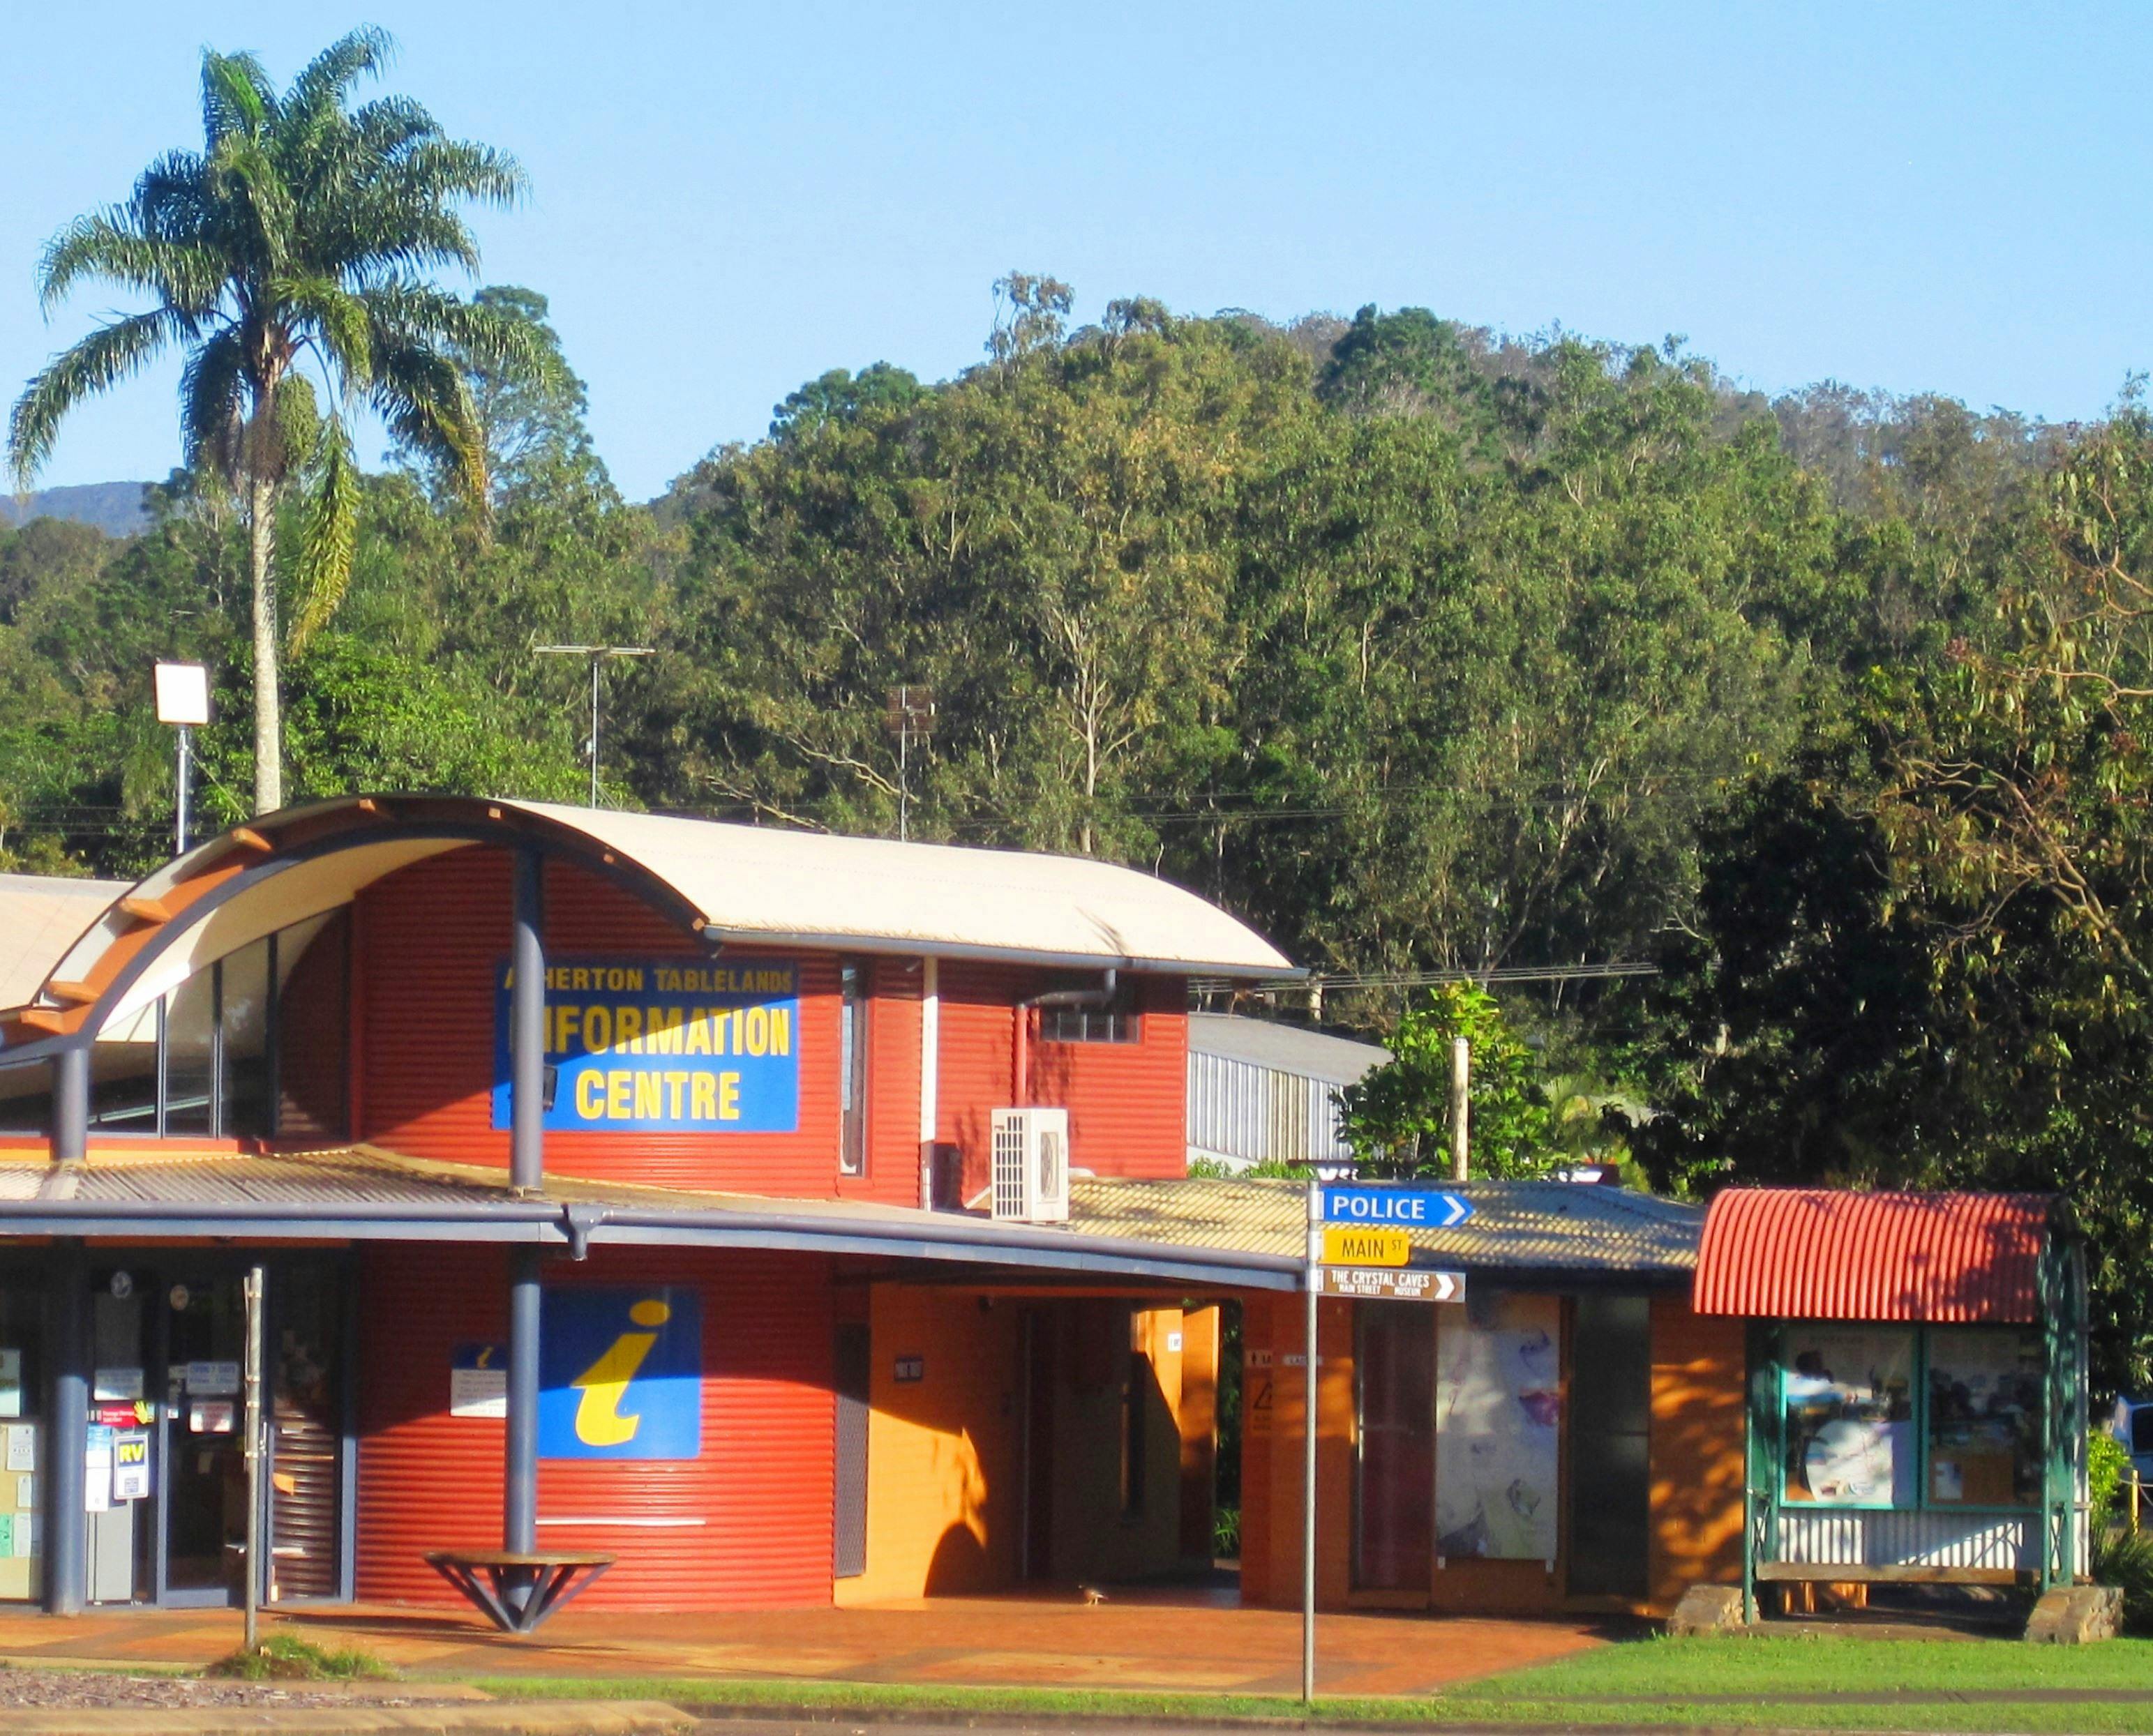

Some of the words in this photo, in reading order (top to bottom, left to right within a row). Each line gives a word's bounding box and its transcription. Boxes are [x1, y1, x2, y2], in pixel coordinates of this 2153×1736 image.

[504, 967, 643, 990] HERTON
[654, 969, 793, 993] TABLELANDS
[511, 1005, 790, 1056] FORMATION
[576, 1069, 740, 1120] CENTRE
[1332, 1195, 1425, 1220] POLICE
[1342, 1238, 1384, 1259] MAIN
[1391, 1239, 1403, 1251] ST
[1331, 1269, 1349, 1284] THE
[1351, 1271, 1395, 1286] CRYSTAL
[1398, 1274, 1430, 1288] CAVES
[1338, 1284, 1356, 1294] MAIN
[1356, 1285, 1381, 1295] STREET
[1394, 1287, 1421, 1297] MUSEUM
[119, 1443, 144, 1463] RV
